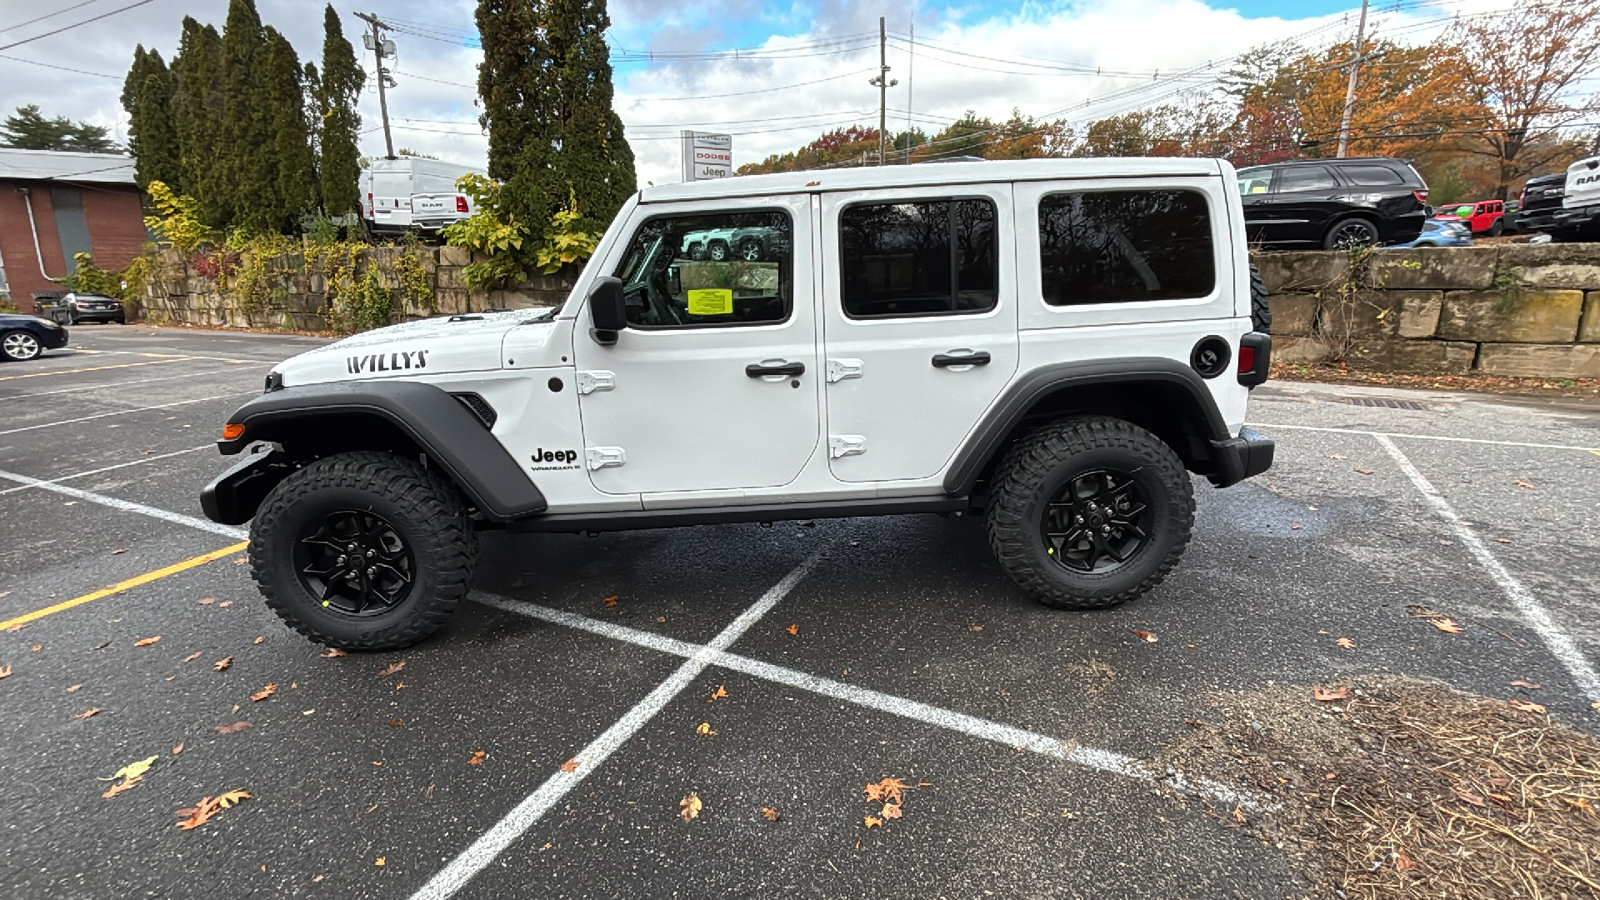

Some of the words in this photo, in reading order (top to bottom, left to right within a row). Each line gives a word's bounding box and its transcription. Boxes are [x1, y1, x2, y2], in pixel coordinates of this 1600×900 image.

[702, 166, 726, 178] Jeep
[346, 349, 429, 374] WILLYS
[530, 447, 578, 464] Jeep
